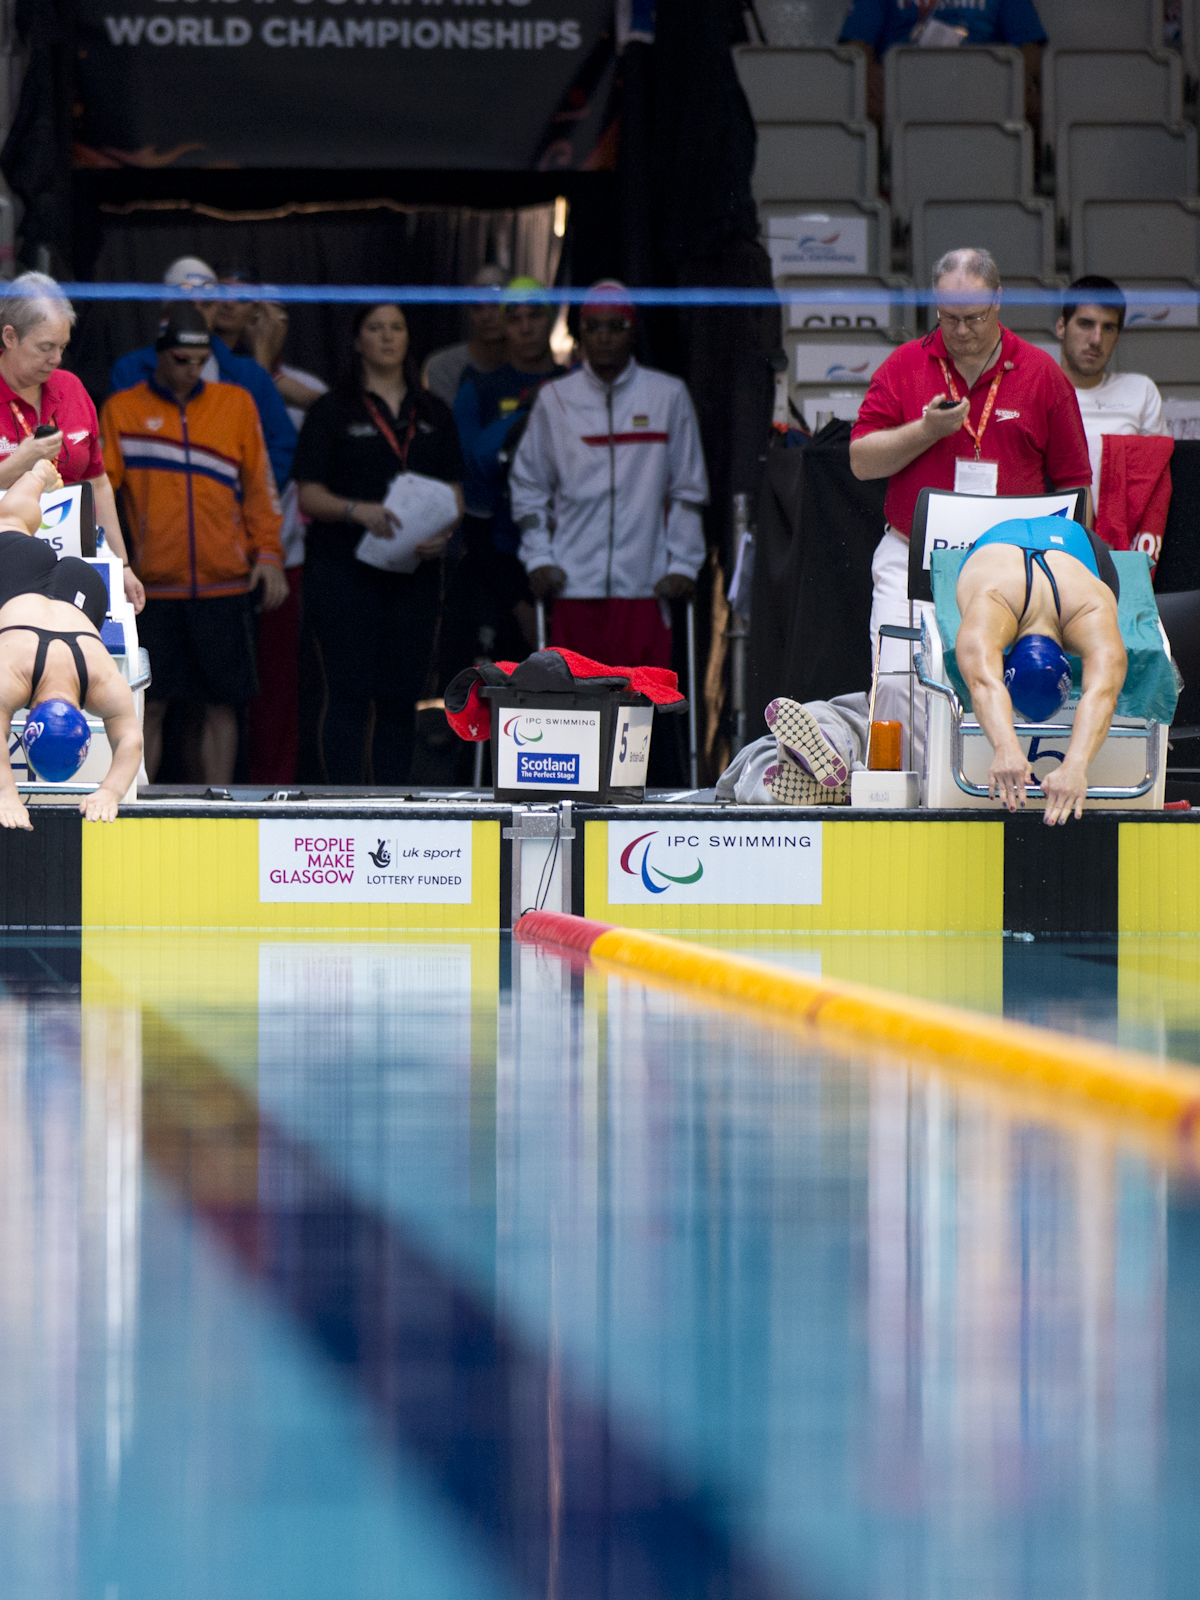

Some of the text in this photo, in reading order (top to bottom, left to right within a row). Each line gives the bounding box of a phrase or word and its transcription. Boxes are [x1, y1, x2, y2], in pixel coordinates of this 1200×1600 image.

[105, 17, 582, 48] WORLD CHAMPIONSHIPS
[995, 409, 1019, 418] speedo
[67, 431, 89, 440] speedo
[545, 718, 596, 726] SWIMMING
[619, 723, 629, 763] 5
[521, 757, 575, 771] Scotland
[557, 772, 575, 780] Stage
[294, 838, 354, 851] PEOPLE
[667, 836, 811, 847] IPC SWIMMING
[402, 847, 461, 860] uk sport
[308, 854, 354, 868] MAKE
[270, 870, 354, 884] GLASGOW
[367, 875, 461, 885] LOTTERY FUNDED
